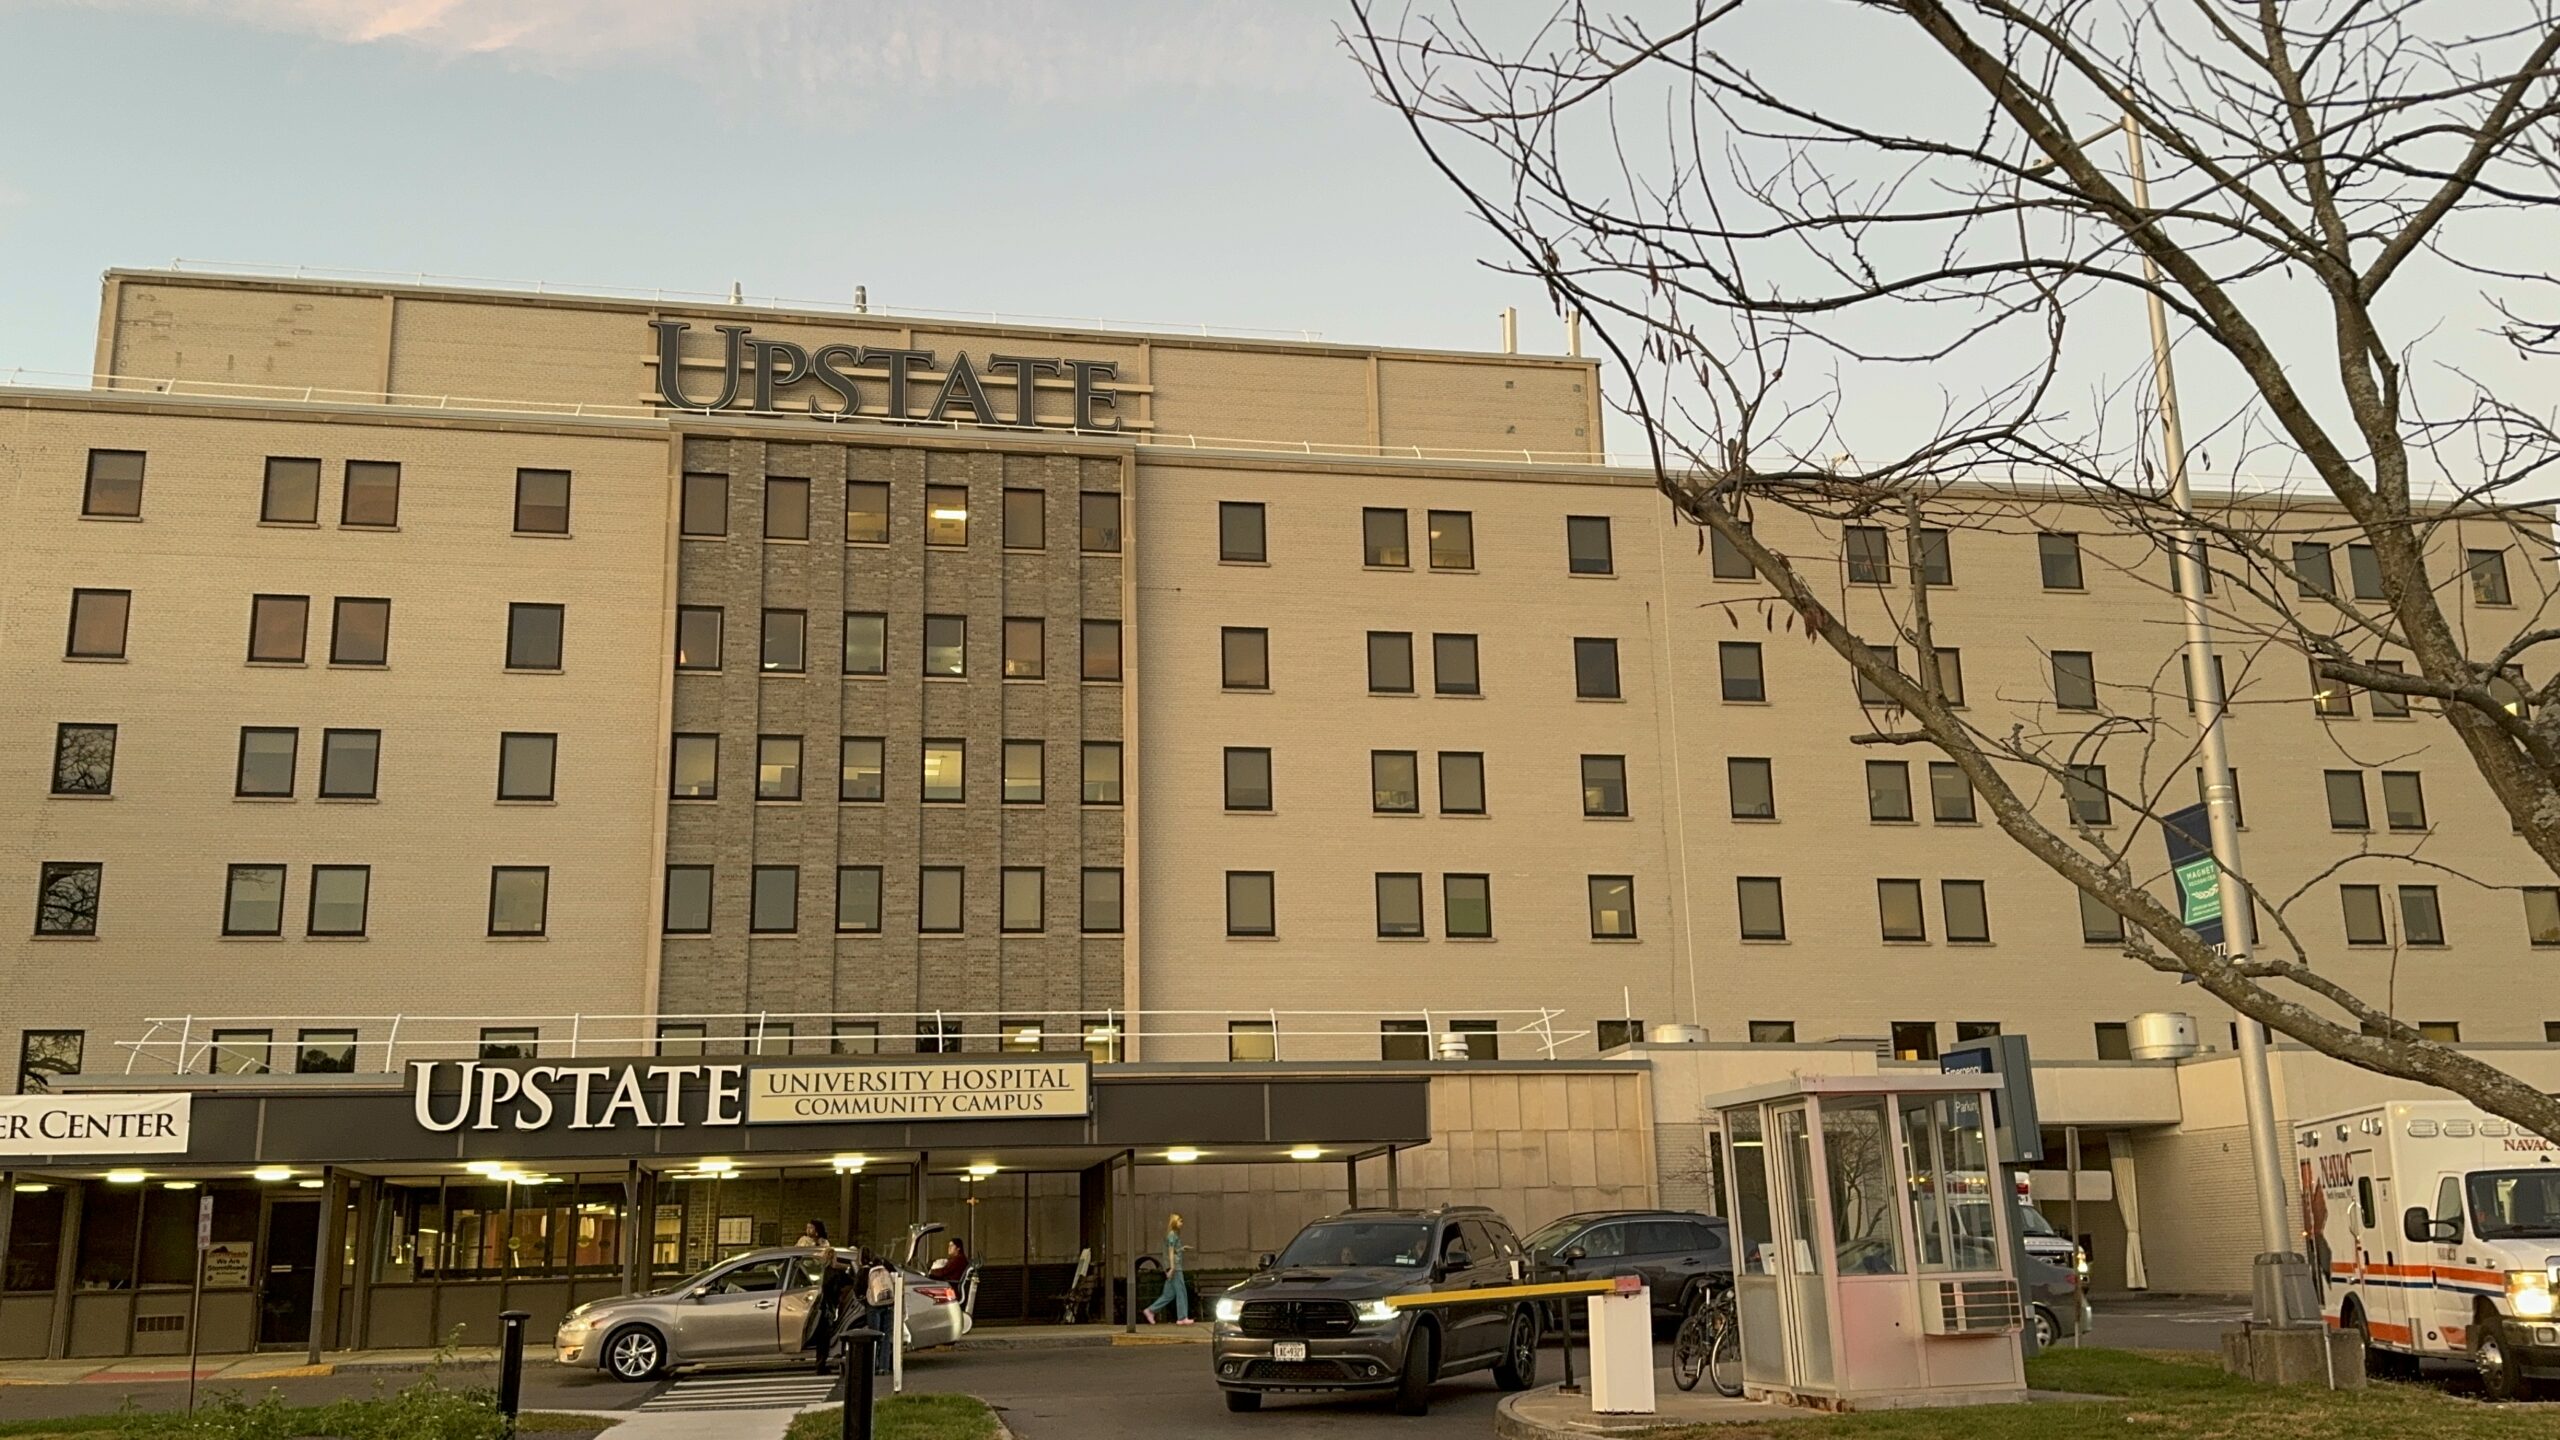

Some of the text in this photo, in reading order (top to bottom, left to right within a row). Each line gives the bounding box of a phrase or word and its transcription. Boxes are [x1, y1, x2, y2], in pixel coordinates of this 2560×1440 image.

[648, 320, 1122, 433] UPSTATE
[769, 1068, 1070, 1094] UNIVERSITY HOSPITAL
[410, 1061, 743, 1132] UPSTATE
[794, 1093, 1043, 1116] COMMUNITY CAMPUS
[39, 1110, 178, 1139] CENTER
[2503, 1139, 2554, 1152] NAVAC
[2319, 1152, 2354, 1188] NAVAC
